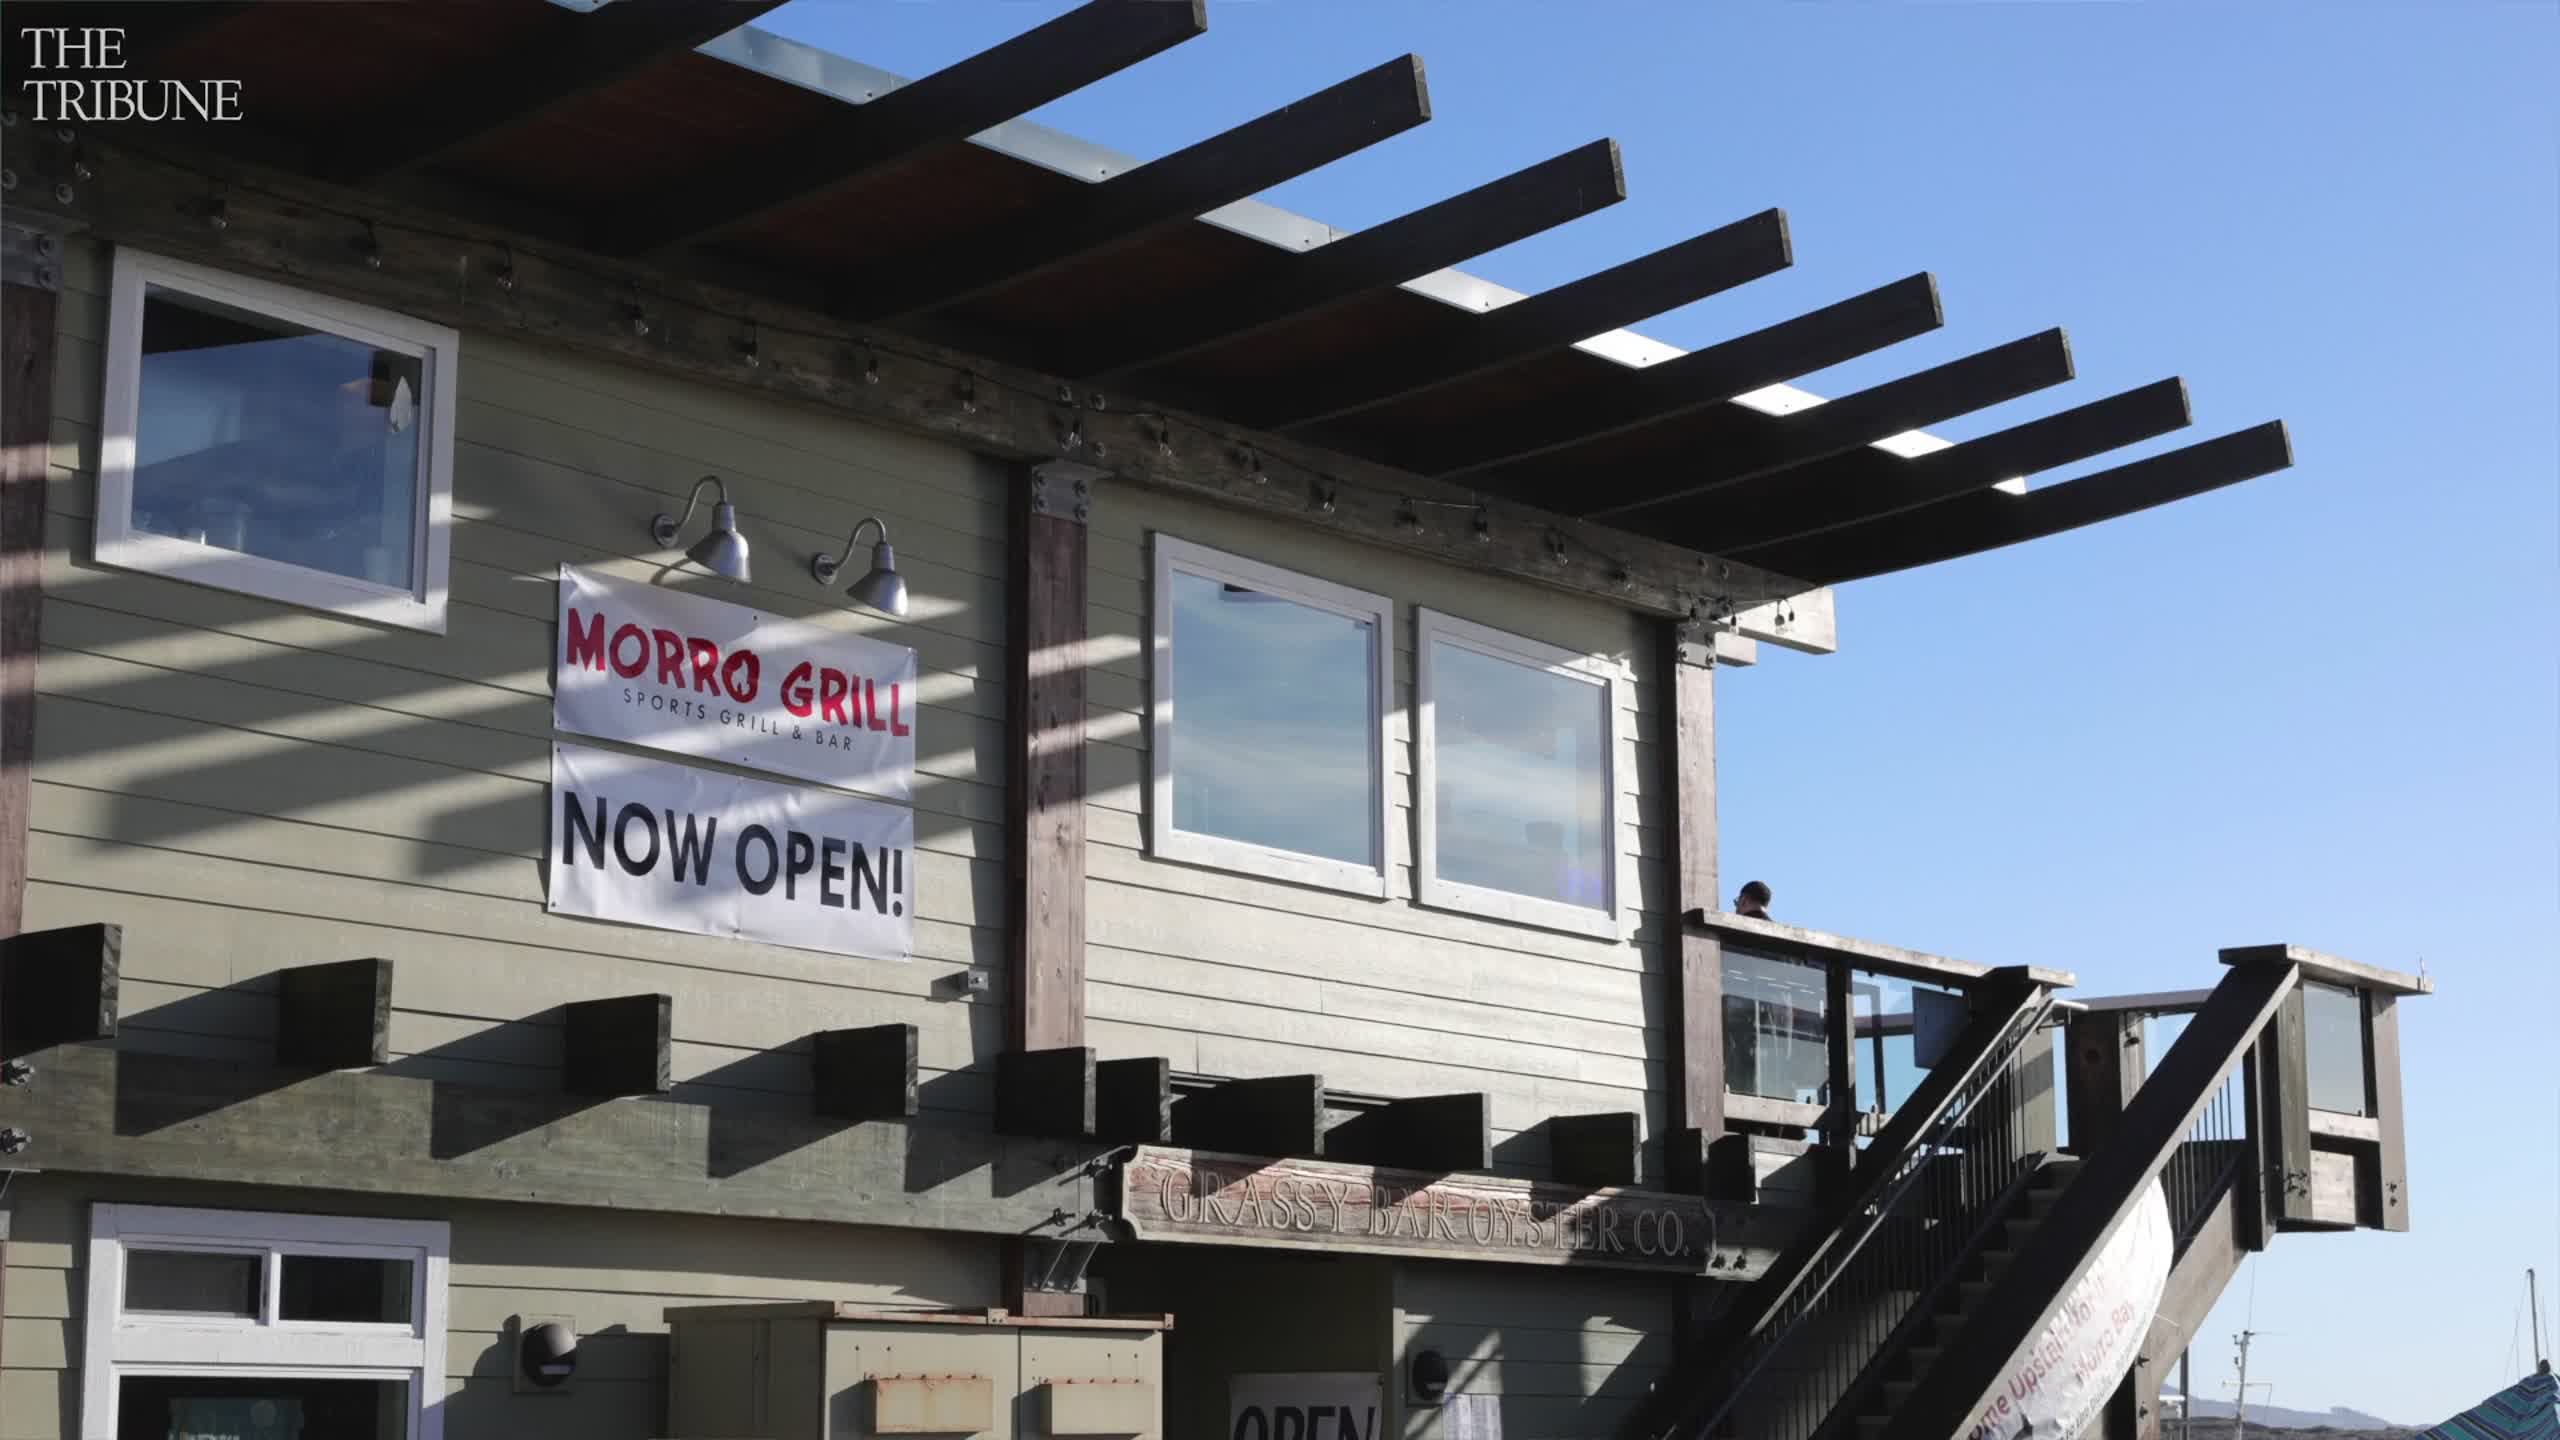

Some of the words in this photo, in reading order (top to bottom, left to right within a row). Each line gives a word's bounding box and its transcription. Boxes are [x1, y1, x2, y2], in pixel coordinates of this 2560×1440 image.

[566, 606, 760, 704] MORRO
[780, 661, 910, 738] GRILL
[623, 687, 706, 720] SPORTS
[720, 709, 779, 736] GRILL
[792, 725, 802, 741] &
[816, 730, 852, 751] BAR
[562, 791, 718, 886] NOW
[735, 823, 904, 918] OPEN!
[1160, 1166, 1351, 1234] GRASSY
[1366, 1183, 1457, 1241] BAR
[1466, 1197, 1625, 1254] OYSTER
[1633, 1207, 1690, 1257] CO.
